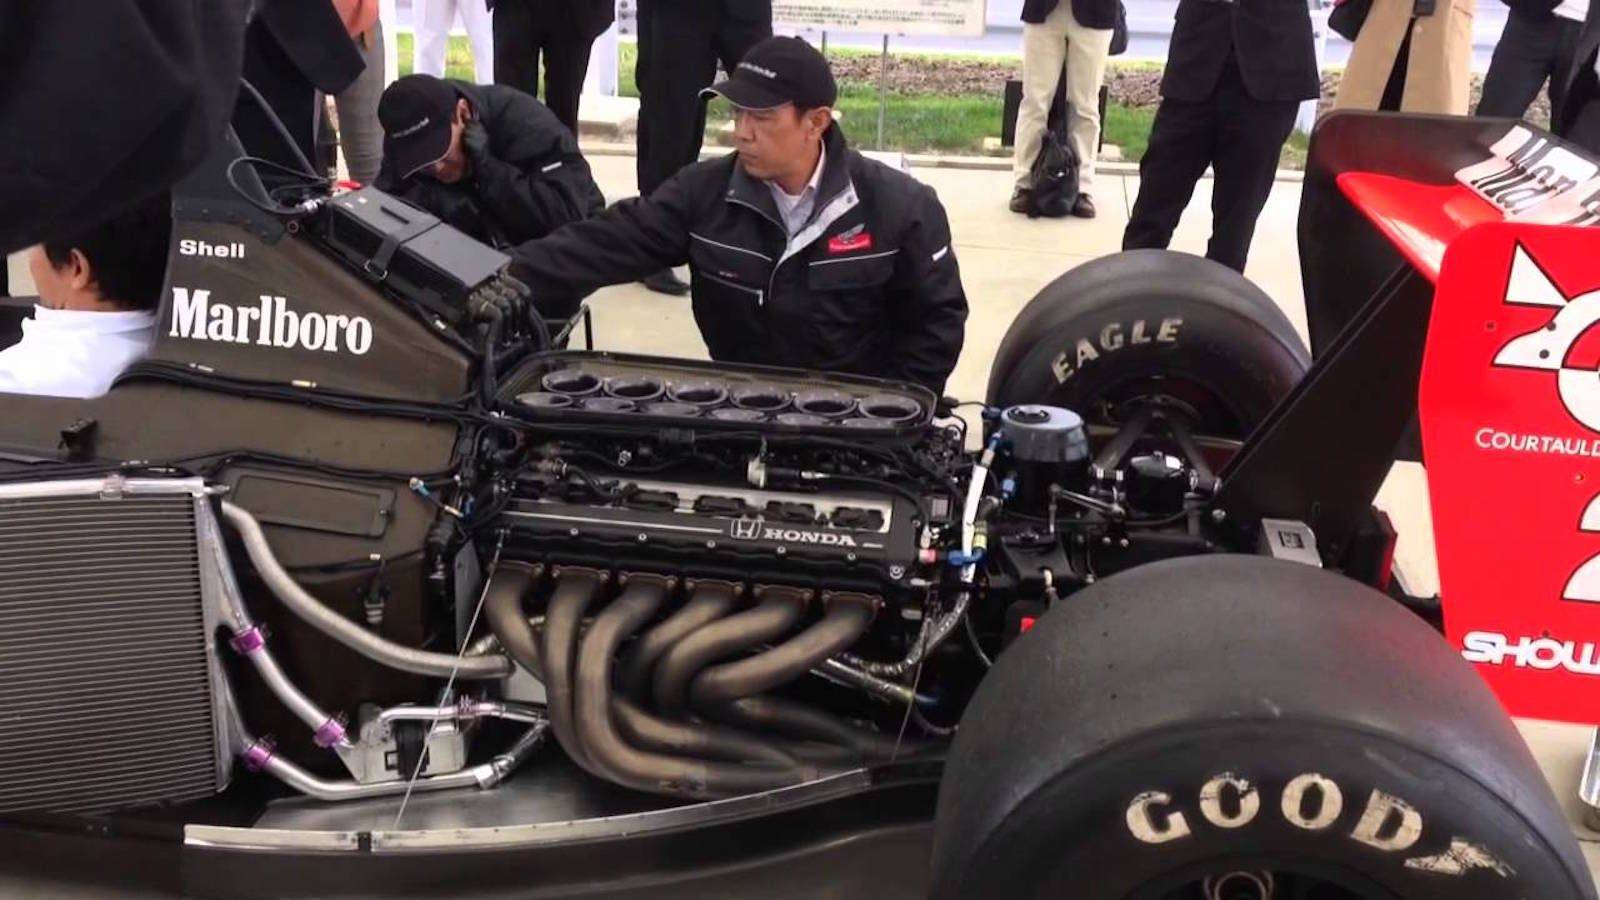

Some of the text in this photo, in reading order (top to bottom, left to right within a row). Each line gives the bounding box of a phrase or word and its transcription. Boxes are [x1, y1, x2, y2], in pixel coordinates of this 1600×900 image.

[179, 239, 245, 258] Shell
[169, 287, 373, 355] Marlboro
[1051, 317, 1183, 384] EAGLE
[763, 528, 857, 547] HONDA
[1126, 771, 1423, 851] GOOD
